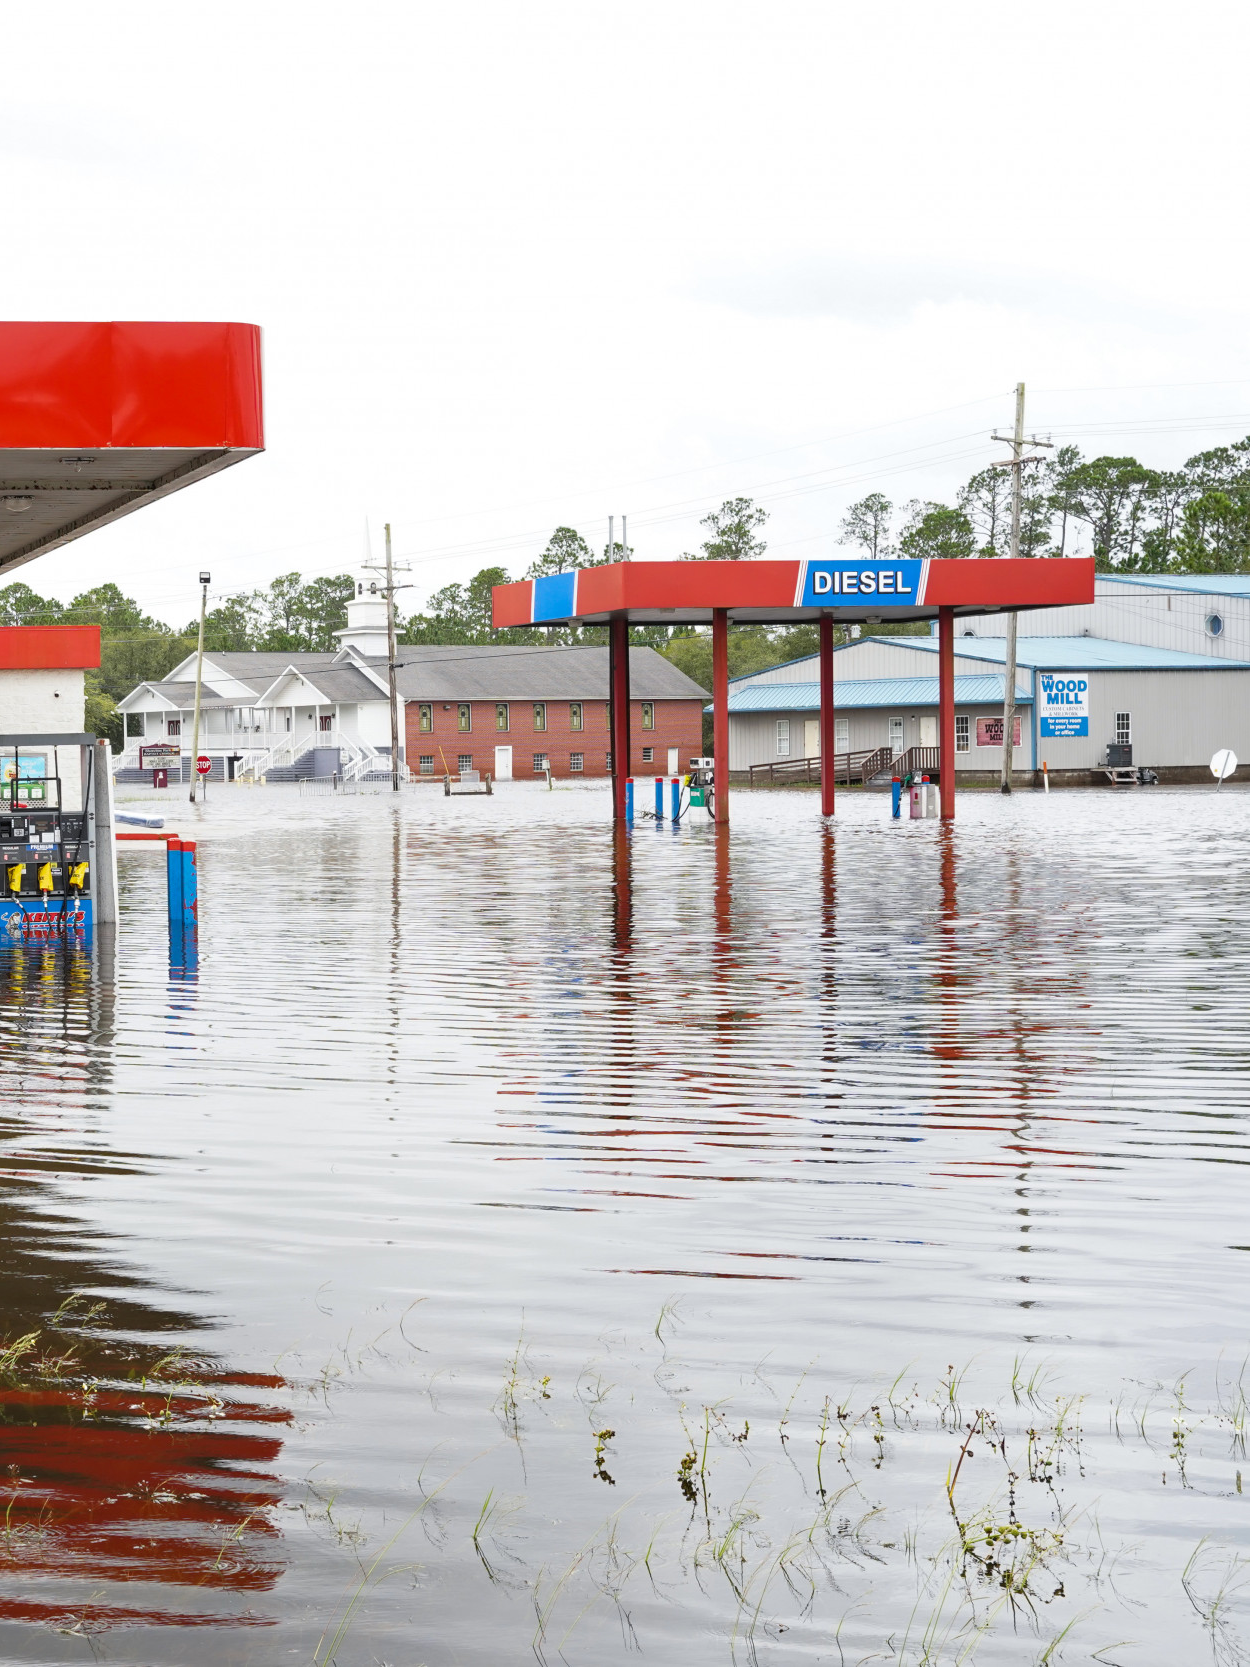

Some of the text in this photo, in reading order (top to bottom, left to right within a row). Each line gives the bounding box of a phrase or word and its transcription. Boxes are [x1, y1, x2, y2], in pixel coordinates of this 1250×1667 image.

[813, 571, 911, 594] DIESEL
[1041, 680, 1087, 692] WOOD
[1047, 693, 1082, 704] MILL
[985, 724, 1004, 733] WOO
[22, 910, 85, 922] KEITH'S
